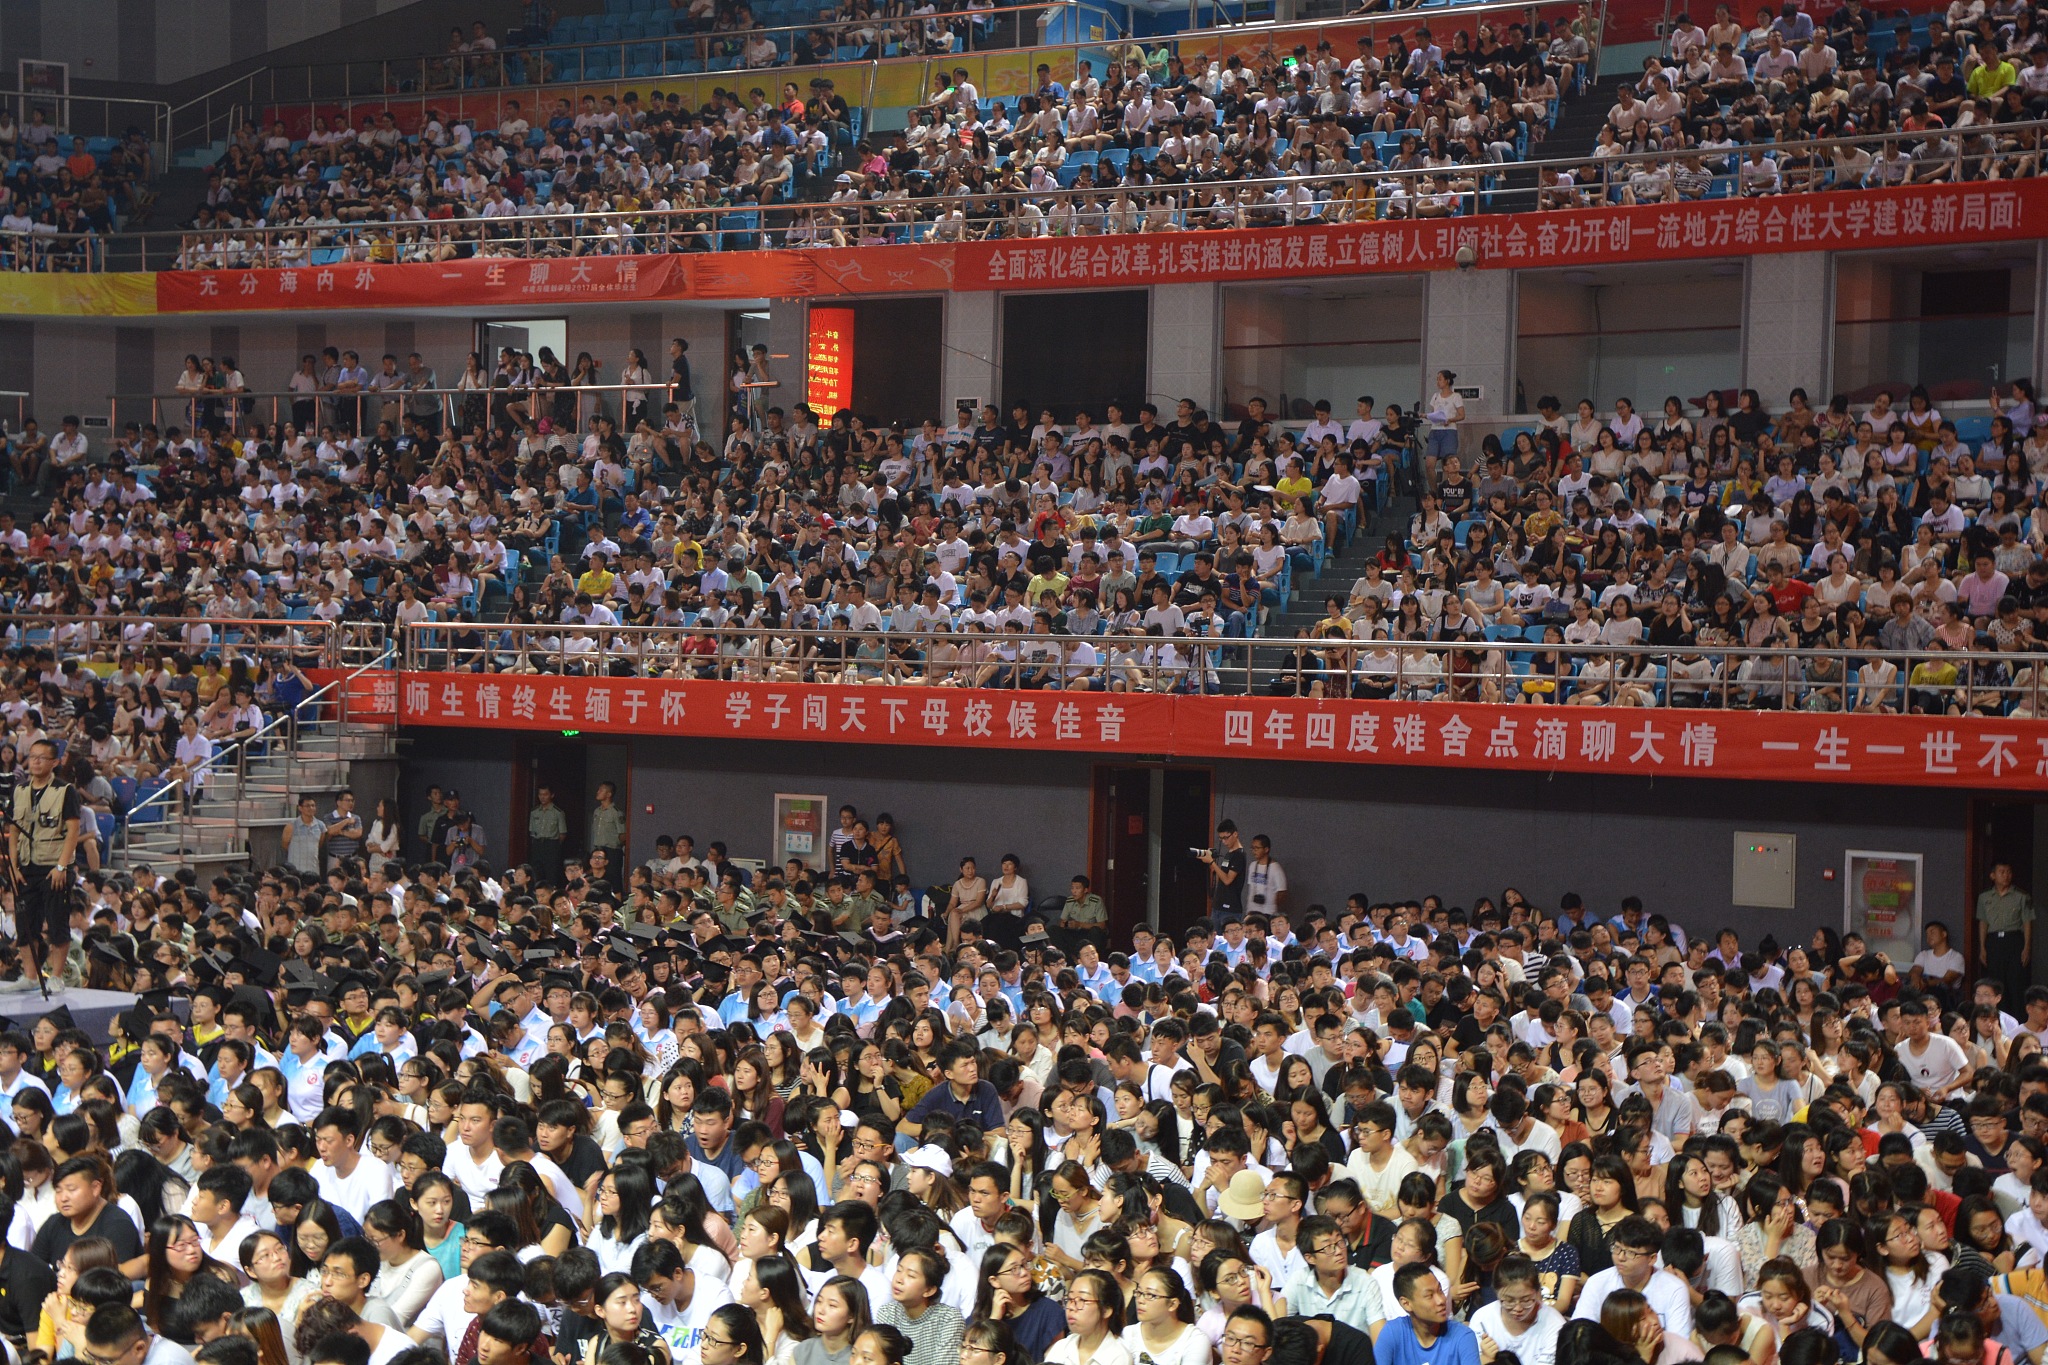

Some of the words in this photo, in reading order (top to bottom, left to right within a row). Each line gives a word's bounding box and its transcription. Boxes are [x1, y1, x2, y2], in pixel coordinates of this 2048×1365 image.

[199, 268, 375, 296] 无分海内外
[441, 259, 639, 287] 一生聊大情
[725, 691, 1126, 742] 学子闯天下母校候佳音
[1224, 708, 1718, 767] 四年四度难舍点滴聊大情
